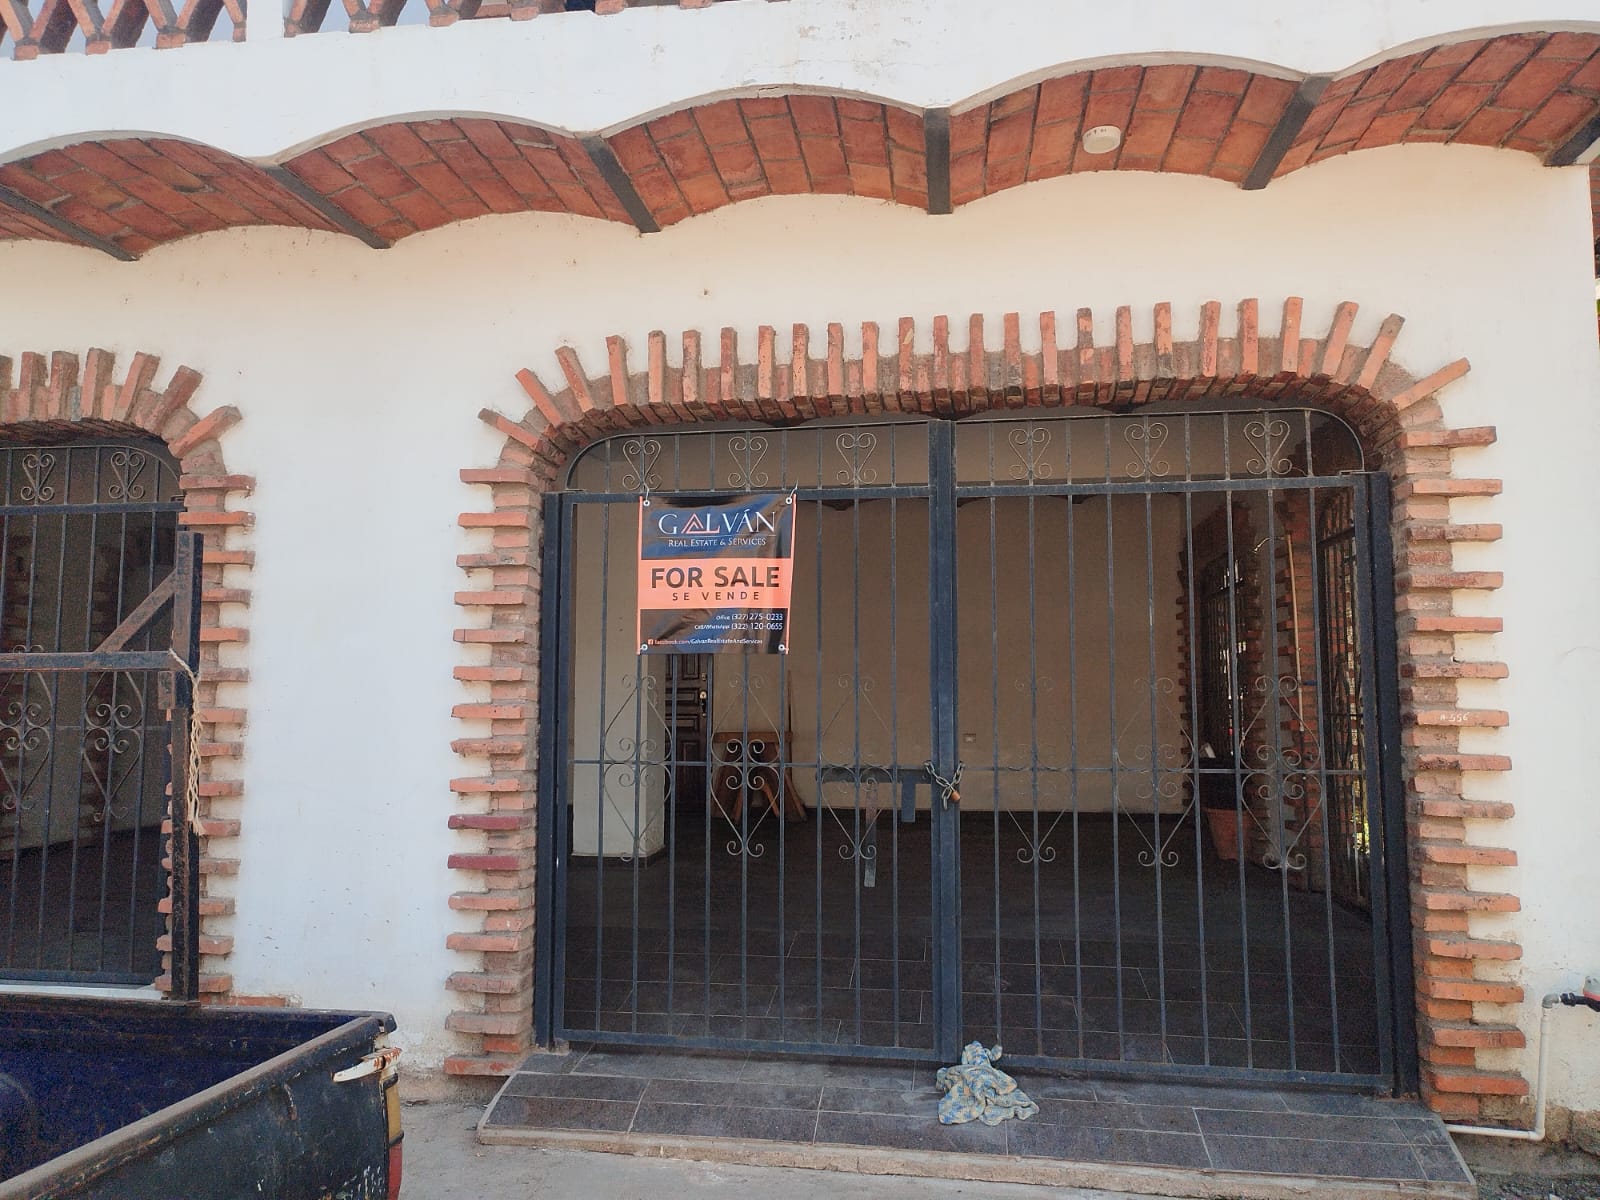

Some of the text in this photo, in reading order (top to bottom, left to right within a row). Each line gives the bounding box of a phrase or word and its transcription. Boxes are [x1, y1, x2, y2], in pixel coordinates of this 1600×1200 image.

[658, 509, 776, 535] GALVÁN
[668, 537, 766, 547] REAL ESTATE & SERVICES
[651, 566, 780, 588] FOR SALE
[672, 591, 760, 601] SE VENDE
[731, 613, 748, 621] (327)
[749, 613, 783, 621] 275-0233
[731, 623, 749, 631] (322)
[750, 622, 783, 631] 120-0655
